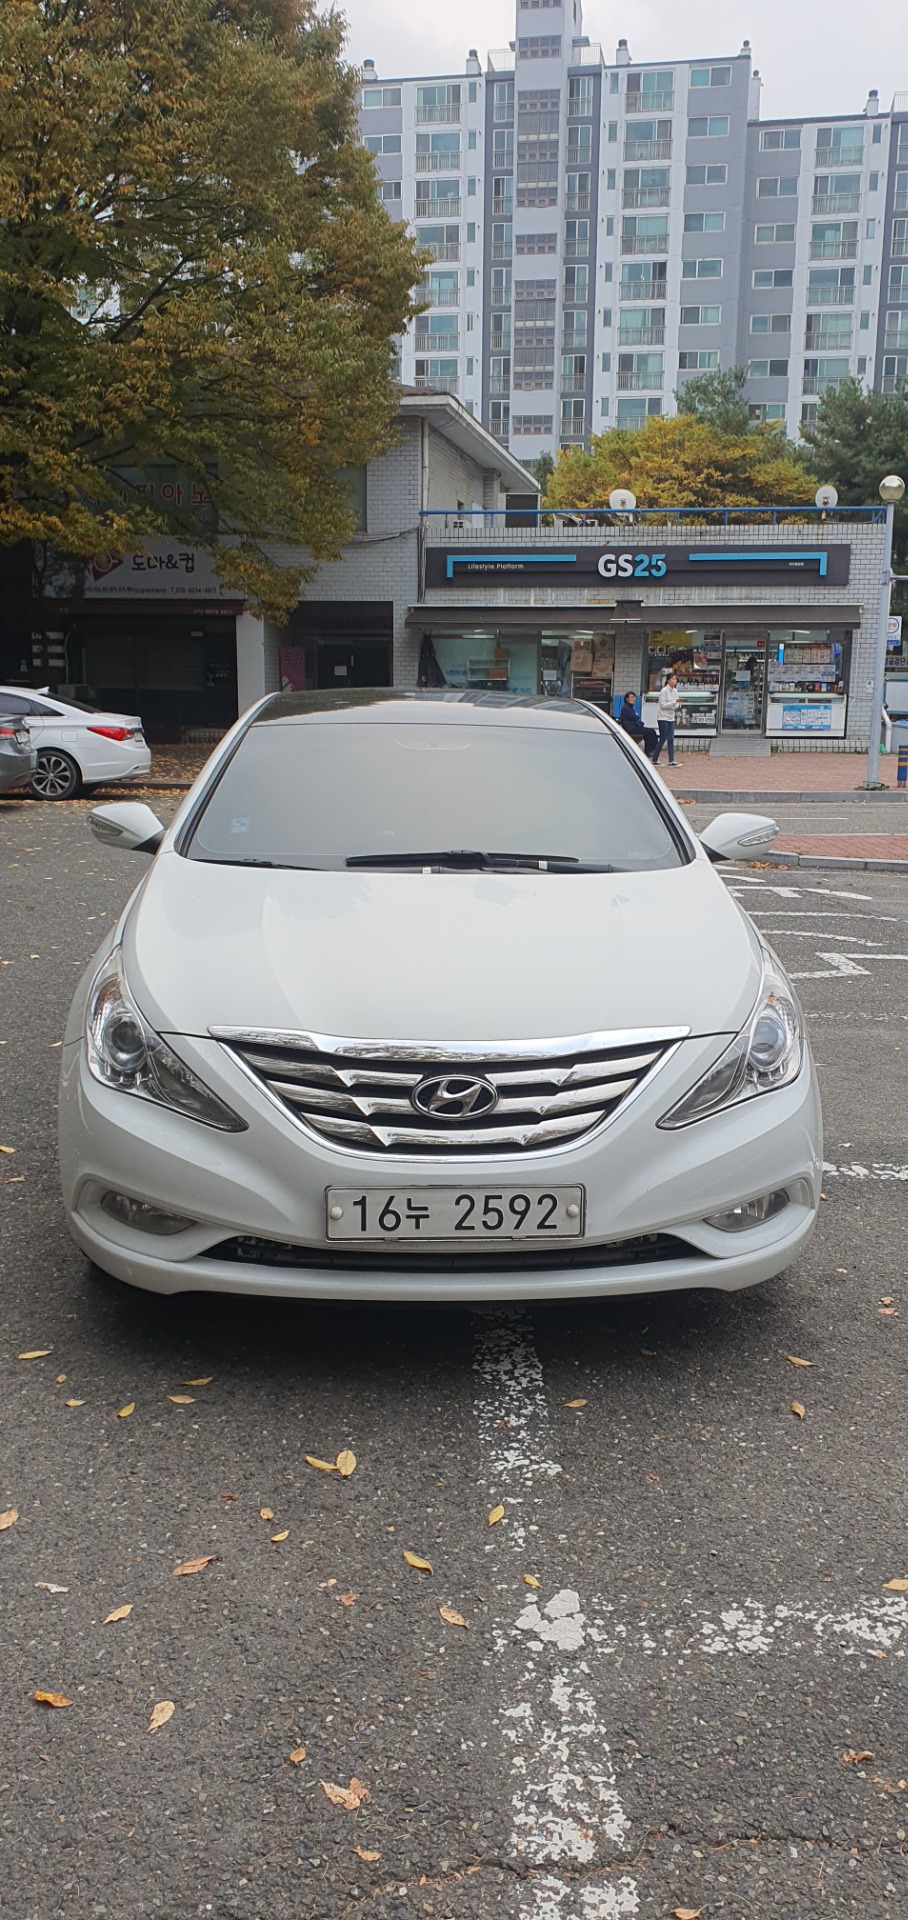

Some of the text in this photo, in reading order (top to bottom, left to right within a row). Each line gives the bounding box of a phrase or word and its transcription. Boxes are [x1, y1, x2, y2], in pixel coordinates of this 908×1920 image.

[131, 552, 195, 573] 도마&컵
[467, 563, 495, 571] Lifestyle
[598, 553, 667, 578] GS25
[352, 1193, 558, 1232] 16누 2592
